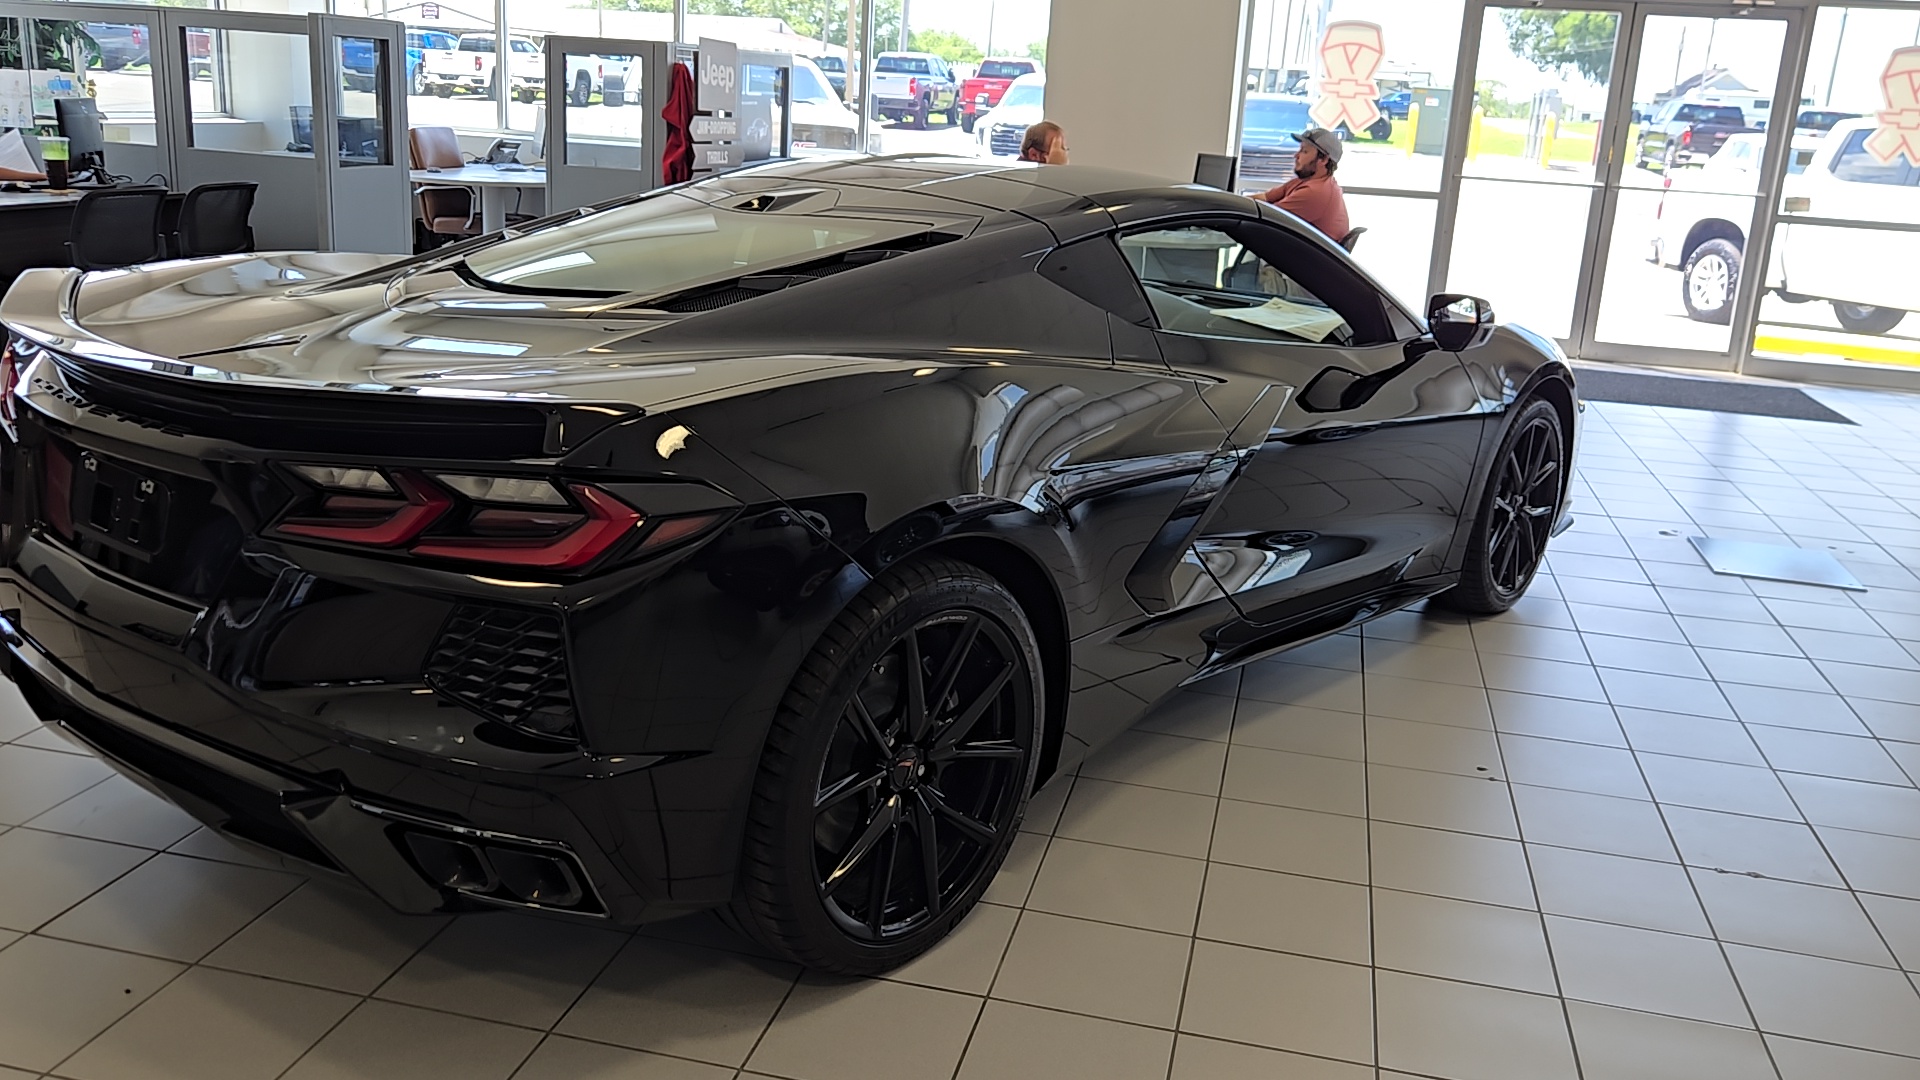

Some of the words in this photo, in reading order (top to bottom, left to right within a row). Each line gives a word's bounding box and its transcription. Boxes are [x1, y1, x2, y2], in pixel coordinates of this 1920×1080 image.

[701, 55, 735, 93] Jeep
[696, 120, 737, 135] JAW-DROPPING
[706, 150, 729, 165] THRILLS
